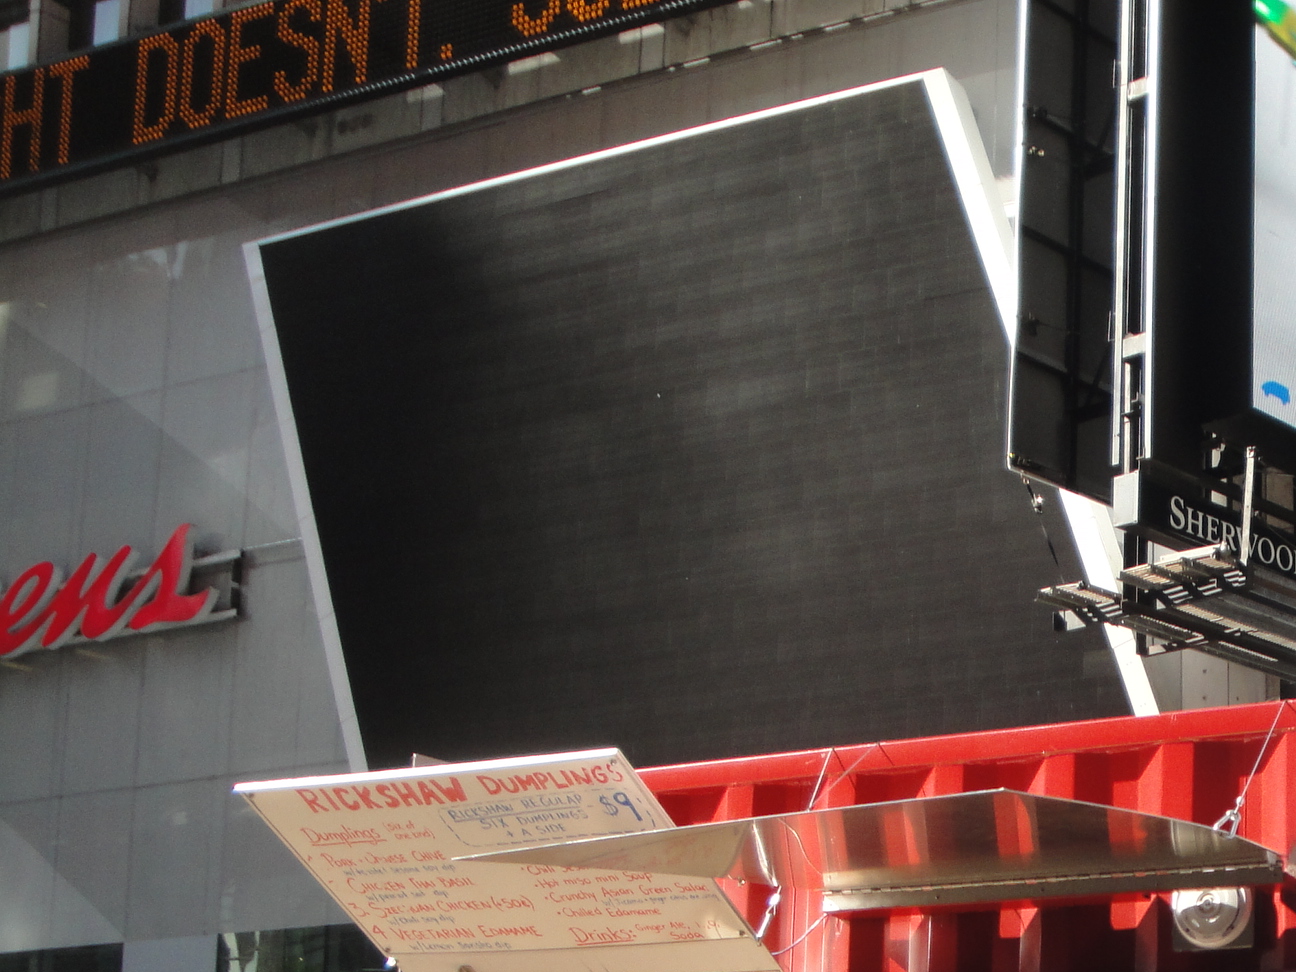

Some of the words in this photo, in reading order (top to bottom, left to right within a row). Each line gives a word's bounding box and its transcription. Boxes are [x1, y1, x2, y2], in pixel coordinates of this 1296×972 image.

[132, 0, 453, 146] DOESNT.
[294, 777, 468, 814] RICKSHAW
[476, 764, 623, 796] DUMPLINGS
[447, 804, 514, 821] RICKSHAW
[599, 792, 643, 822] $9
[479, 818, 509, 829] SIX
[516, 808, 589, 825] DUMPLINGS
[301, 824, 381, 848] Dumplings
[538, 824, 566, 834] SIDE
[411, 850, 447, 862] CHIVE
[408, 877, 437, 889] THAI
[436, 877, 476, 888] BASIL
[622, 871, 653, 884] Soup
[549, 892, 598, 904] Crunchy
[601, 886, 634, 897] Asian
[638, 884, 672, 896] Green
[368, 902, 436, 918] SZECUAN
[436, 899, 491, 913] CHICKEN
[562, 903, 602, 918] Chilled
[605, 907, 661, 918] Edamame
[390, 927, 476, 941] VEGETARIAN
[477, 925, 543, 938] EDAMAME
[568, 926, 637, 945] Drinks:
[635, 924, 666, 934] Ginger
[669, 931, 705, 941] Soda
